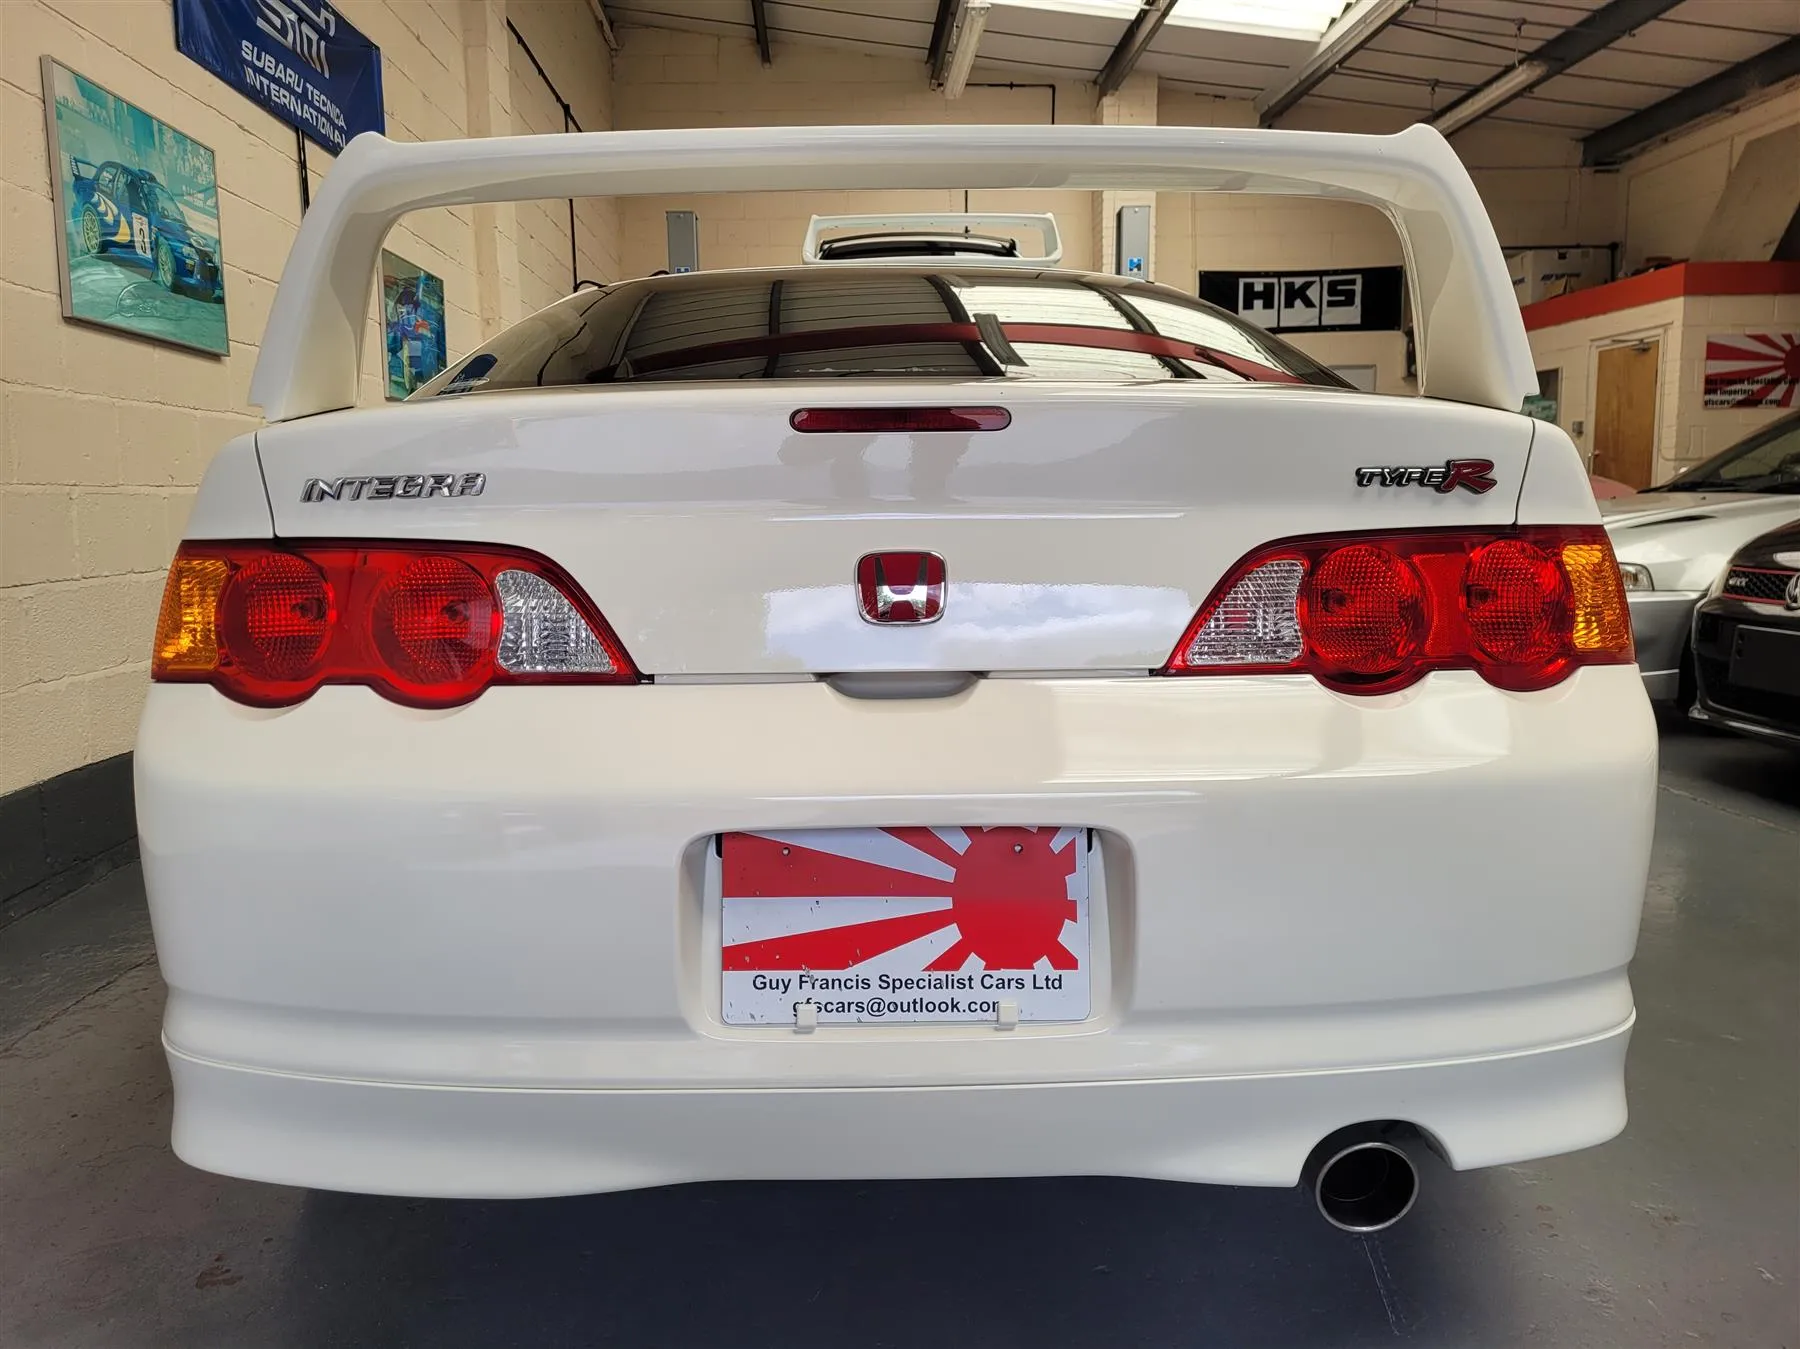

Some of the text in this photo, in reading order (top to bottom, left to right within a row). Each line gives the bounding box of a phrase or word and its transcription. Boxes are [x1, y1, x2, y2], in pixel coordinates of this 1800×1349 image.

[241, 39, 348, 131] SUBARU TECNICA
[1242, 278, 1358, 311] HKS
[299, 472, 487, 503] INTEGRA
[752, 974, 1063, 994] Guy Francis Specialist Cars Ltd
